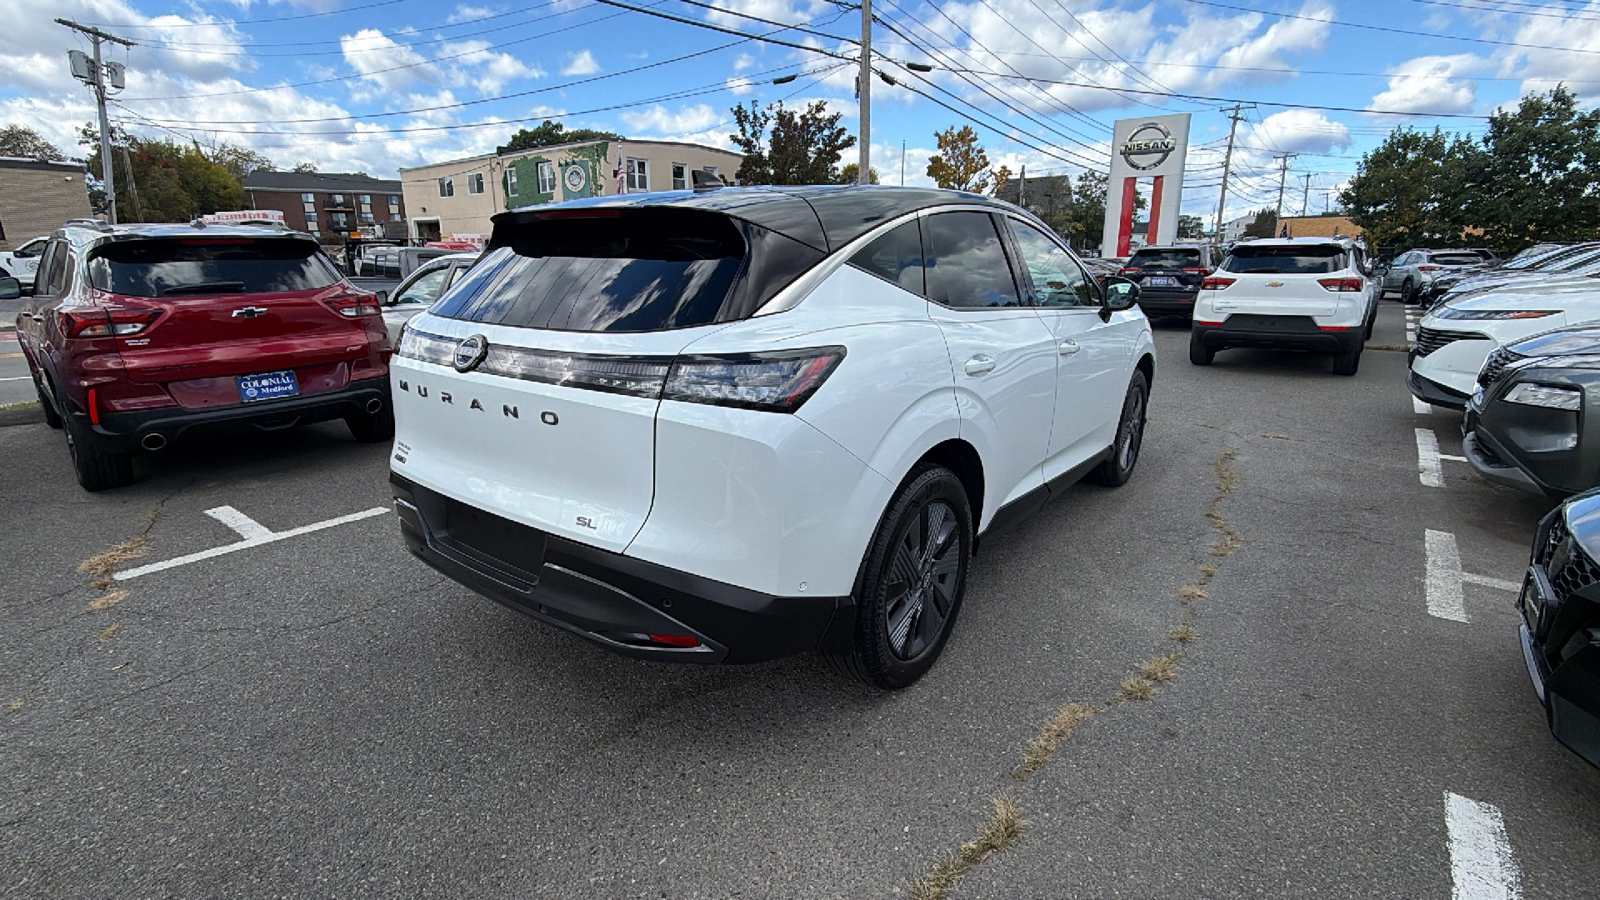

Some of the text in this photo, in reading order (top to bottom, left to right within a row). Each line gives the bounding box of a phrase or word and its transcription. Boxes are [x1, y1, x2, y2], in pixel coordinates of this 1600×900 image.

[1124, 142, 1170, 152] NISSAN
[241, 376, 294, 389] COLONIAL
[261, 384, 293, 394] Medford
[399, 379, 559, 426] MURANO
[576, 516, 597, 530] SL
